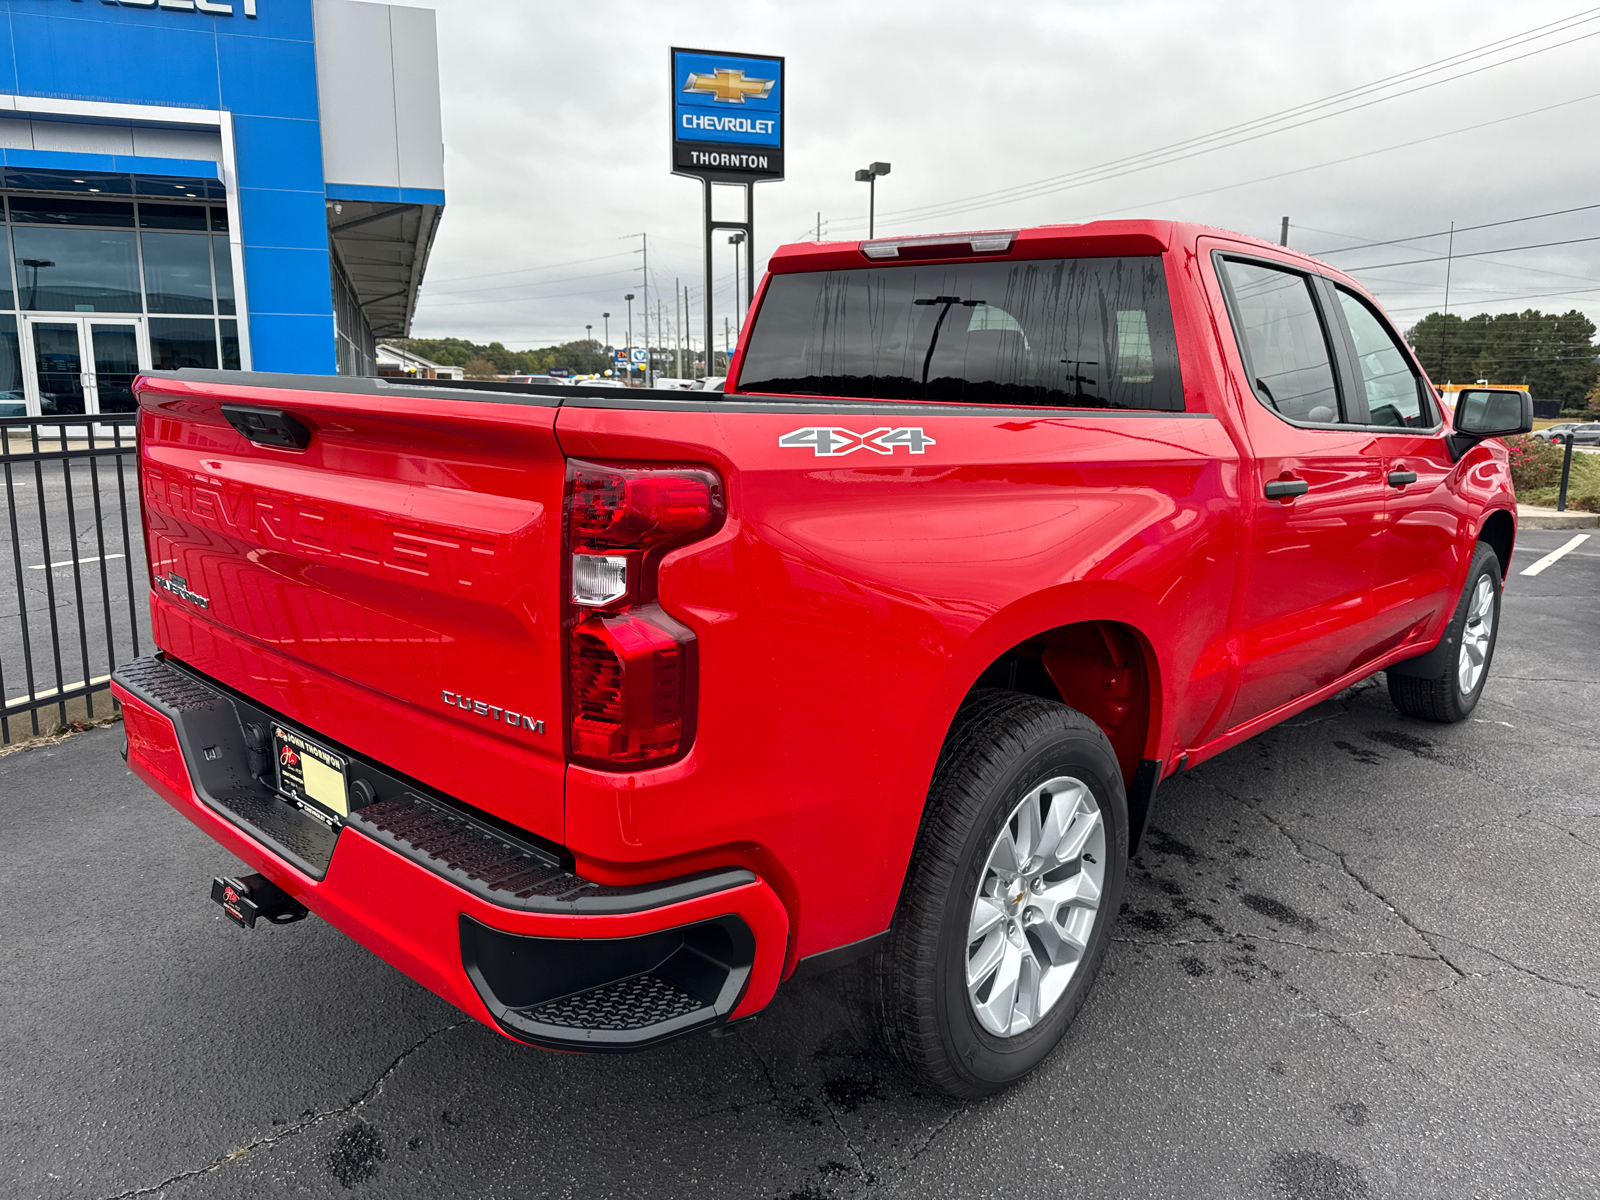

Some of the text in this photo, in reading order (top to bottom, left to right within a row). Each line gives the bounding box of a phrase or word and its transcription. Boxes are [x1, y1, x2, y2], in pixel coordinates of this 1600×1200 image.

[682, 114, 775, 134] CHEVROLET
[691, 151, 768, 168] THORNTON
[145, 468, 496, 587] CHEVROLET
[442, 690, 544, 734] CUSTOM
[287, 733, 340, 769] JOHN THORNTON
